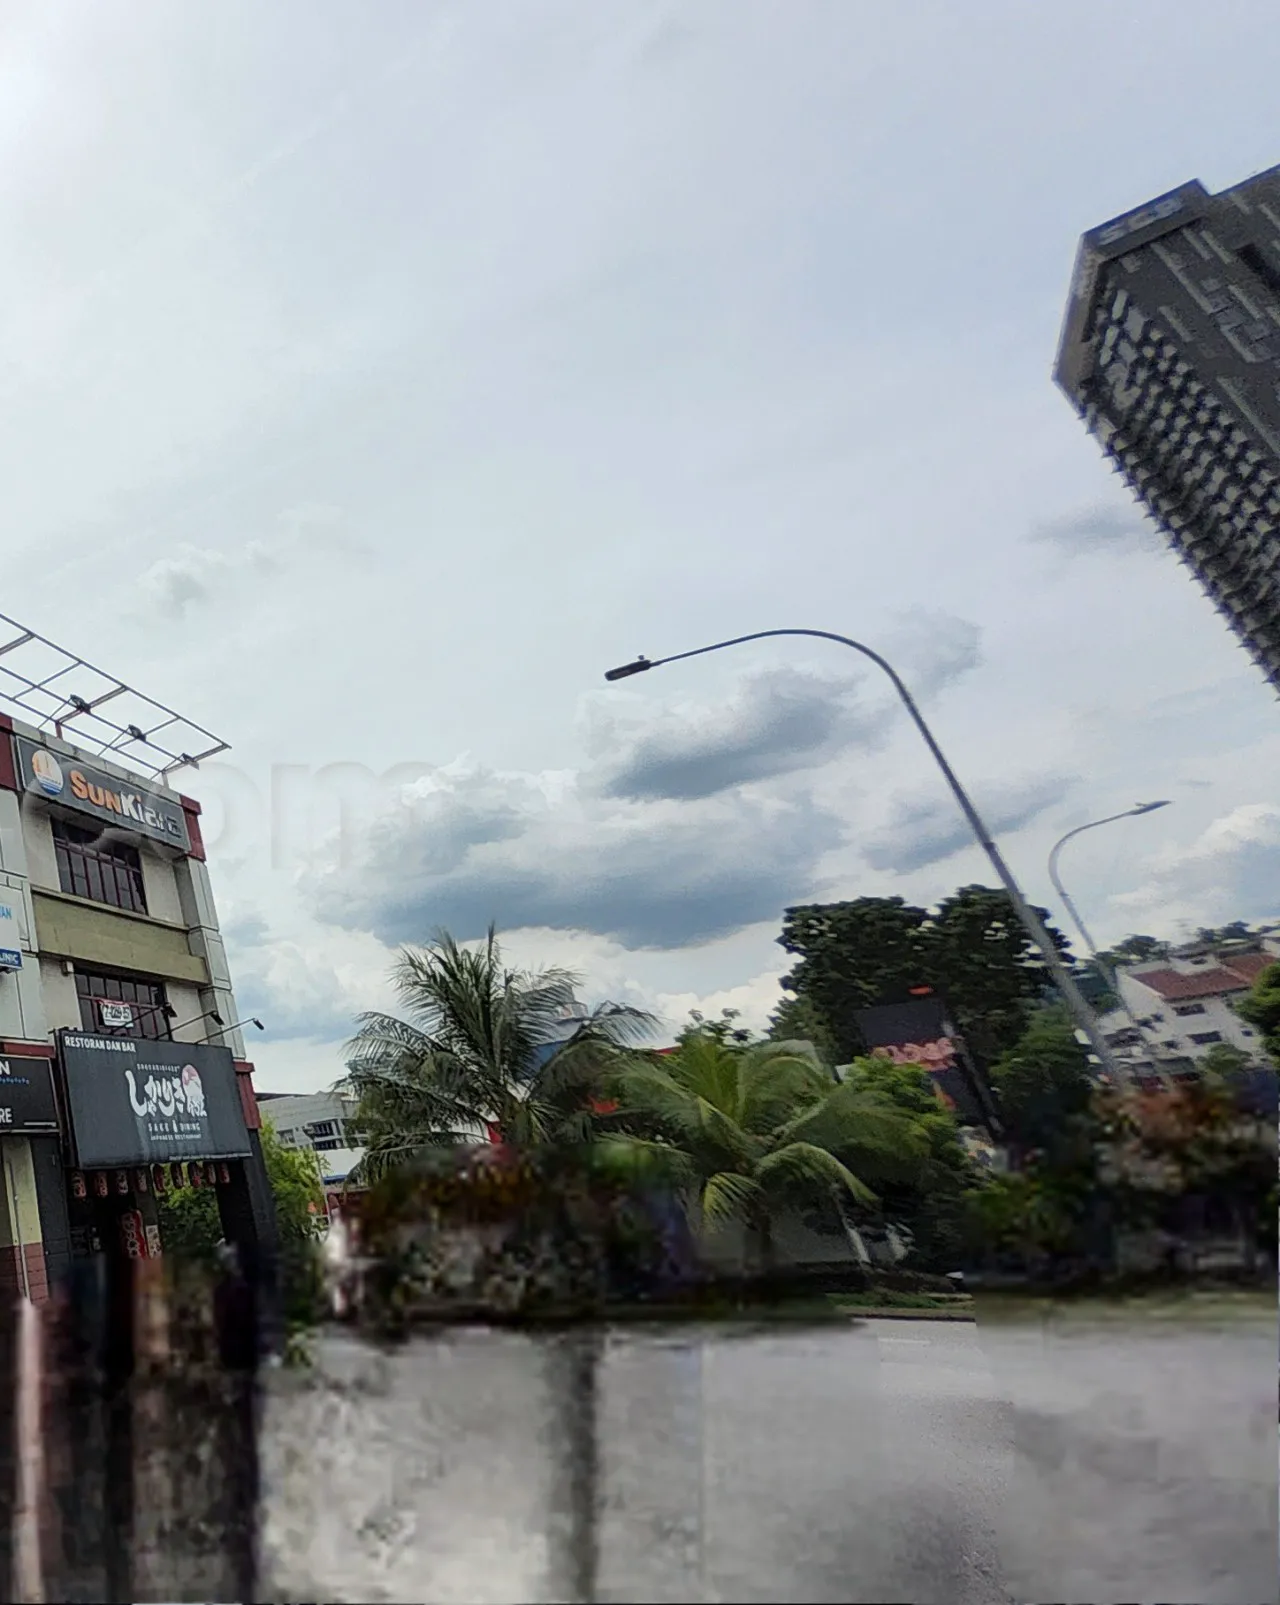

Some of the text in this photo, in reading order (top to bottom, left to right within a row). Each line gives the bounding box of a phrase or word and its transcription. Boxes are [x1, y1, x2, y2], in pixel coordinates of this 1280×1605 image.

[64, 1036, 136, 1053] RESTORAN DAN BAR
